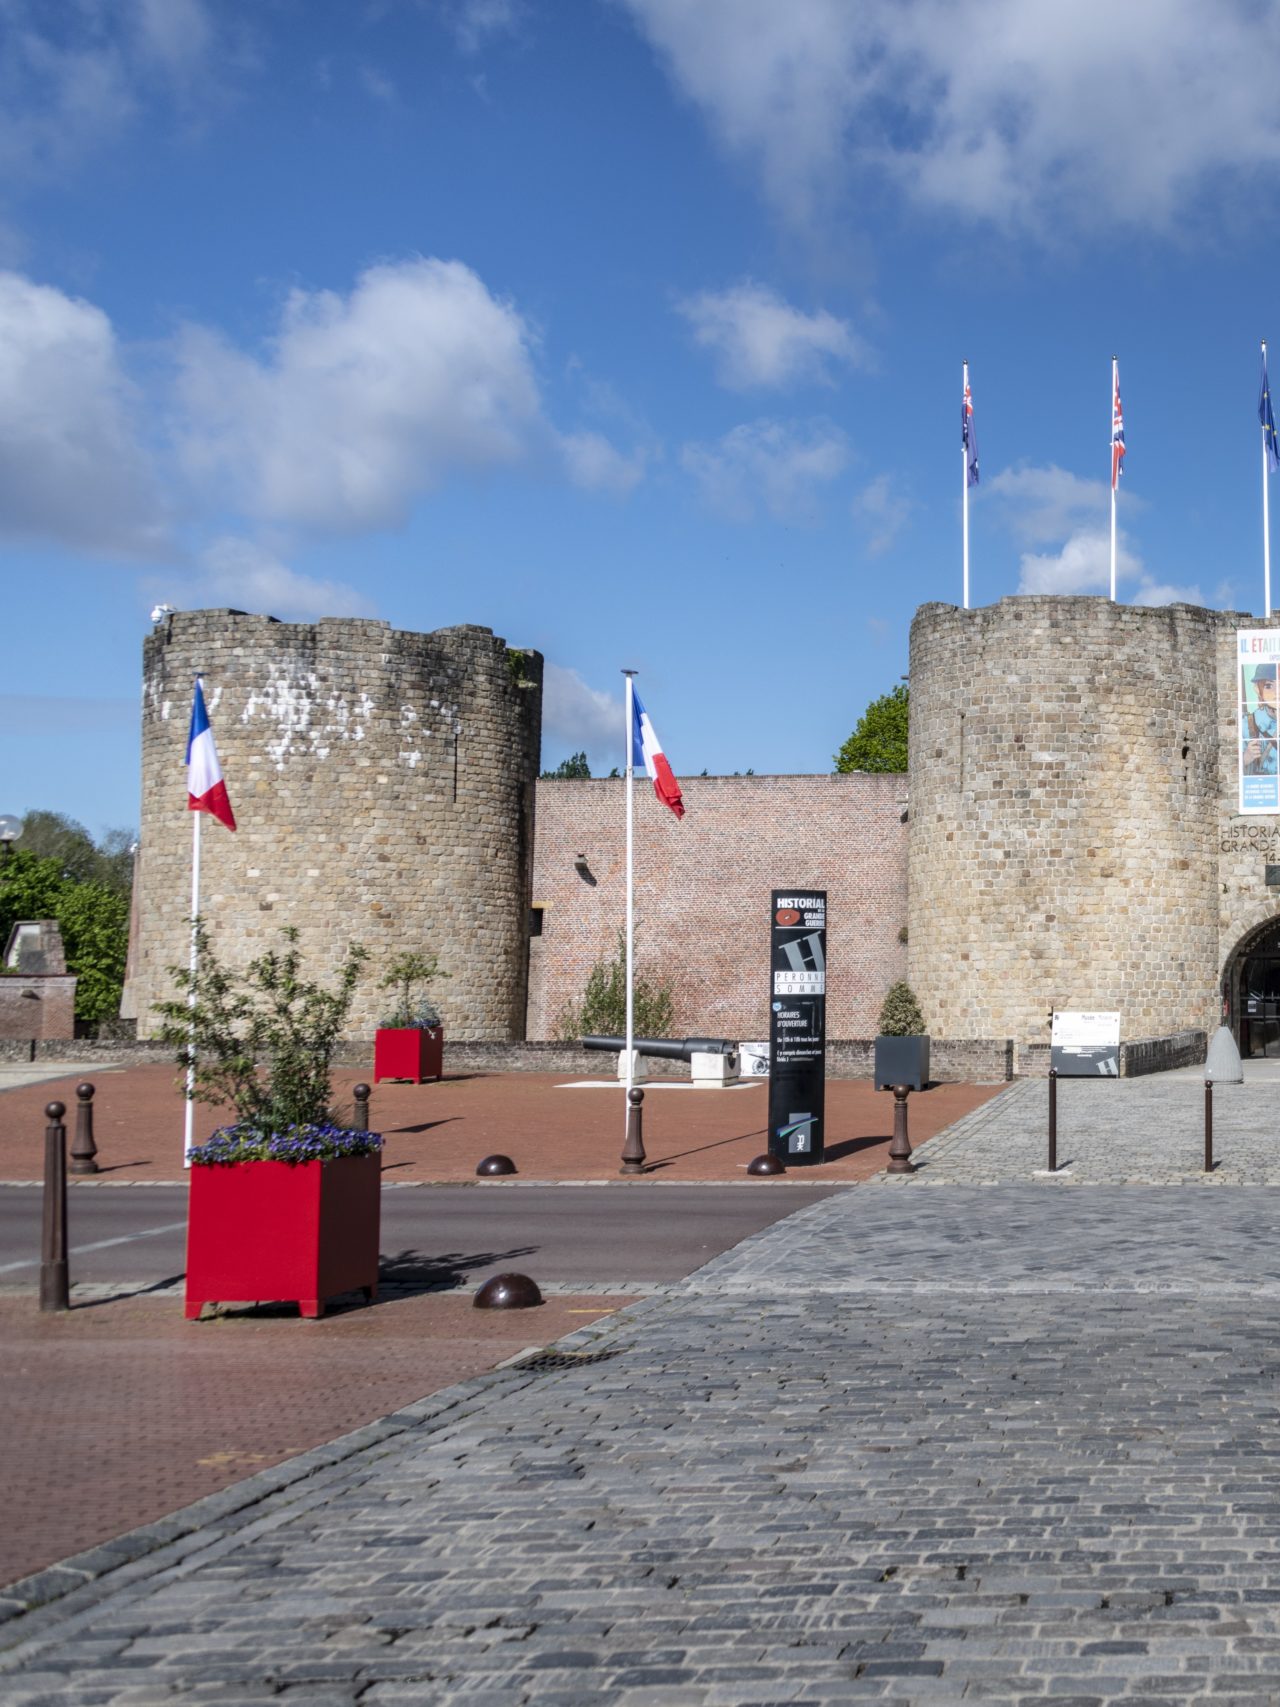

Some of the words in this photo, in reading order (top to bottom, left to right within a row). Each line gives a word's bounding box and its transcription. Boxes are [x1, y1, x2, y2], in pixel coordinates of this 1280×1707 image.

[1240, 638, 1249, 653] IL
[1220, 840, 1276, 853] GRANDE
[777, 898, 825, 908] HISTORIAL
[803, 912, 825, 920] GRANDE
[776, 973, 824, 982] PERONNE
[776, 984, 824, 993] SOMME
[777, 1011, 800, 1019] HORAIRES
